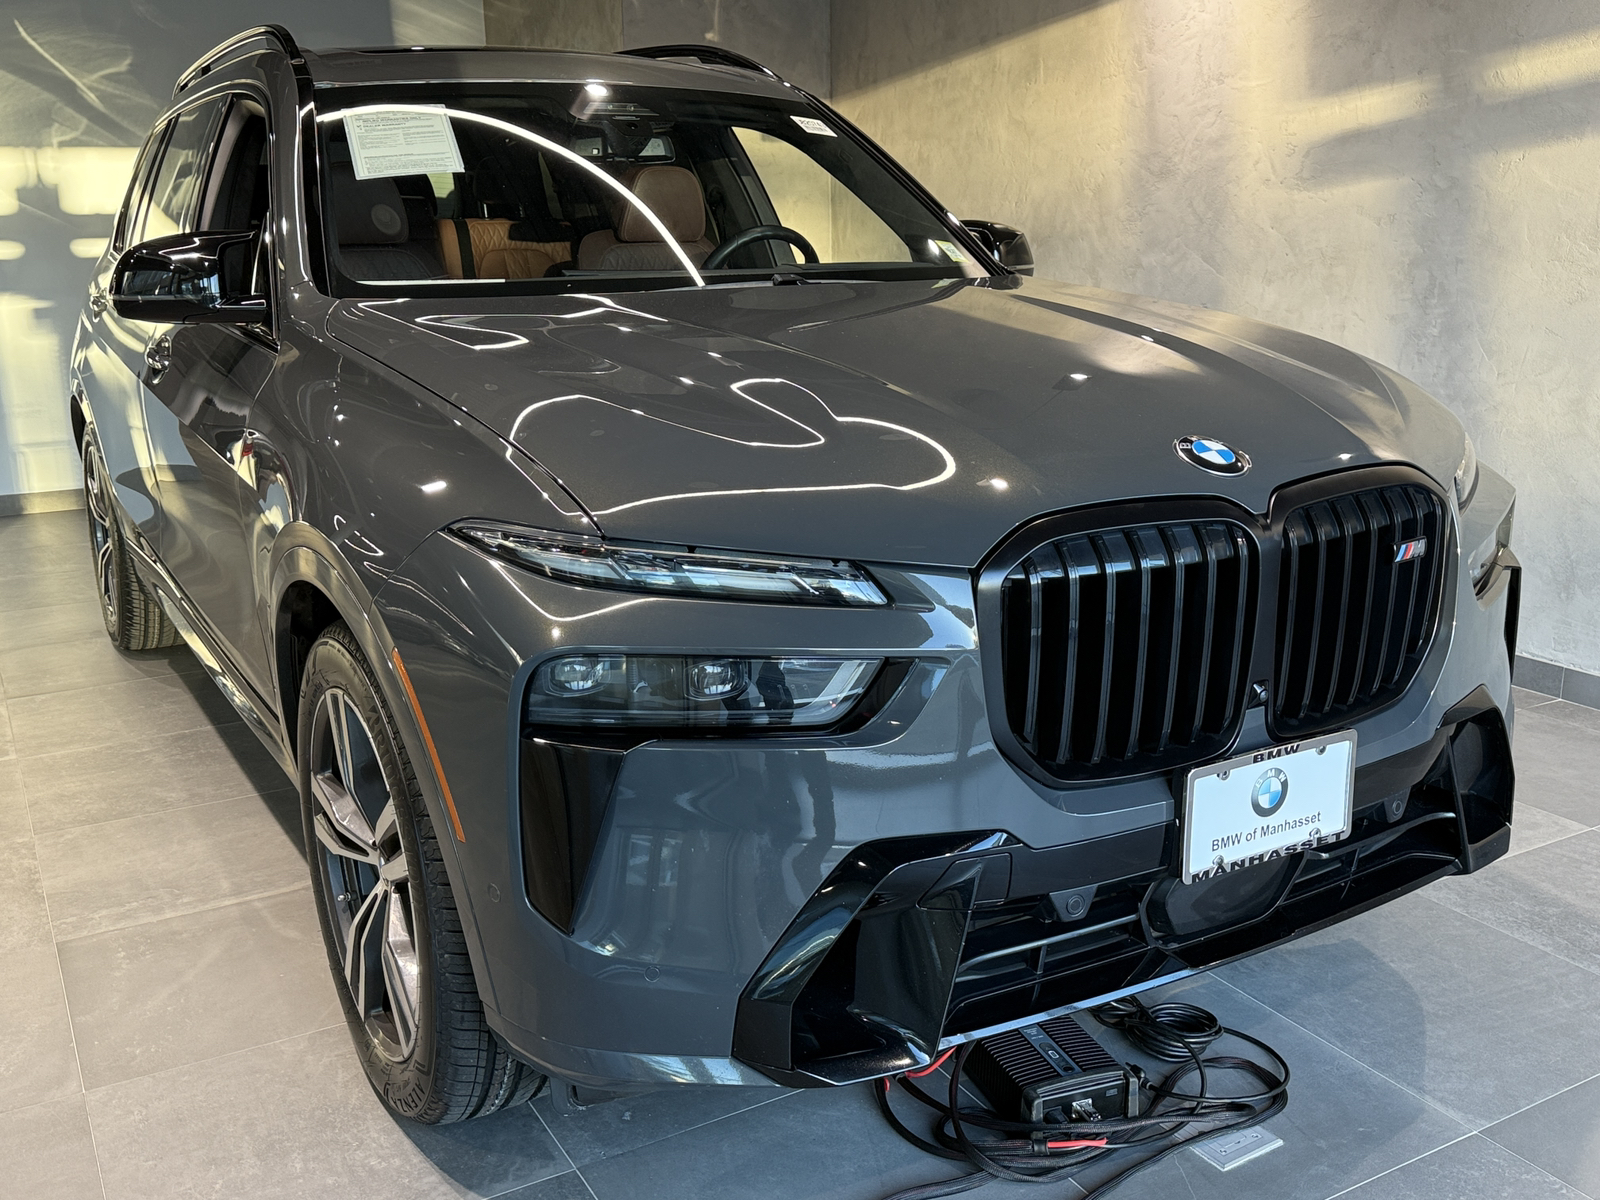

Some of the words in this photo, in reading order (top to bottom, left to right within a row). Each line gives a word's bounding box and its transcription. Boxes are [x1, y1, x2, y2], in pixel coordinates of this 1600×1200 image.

[1252, 744, 1301, 764] BMW
[1255, 769, 1287, 788] BMW
[1211, 831, 1242, 852] BMW
[1245, 827, 1258, 842] of
[1260, 811, 1322, 837] Manhasset
[1191, 831, 1346, 884] MANHASSET
[390, 1077, 425, 1113] ALENZA
